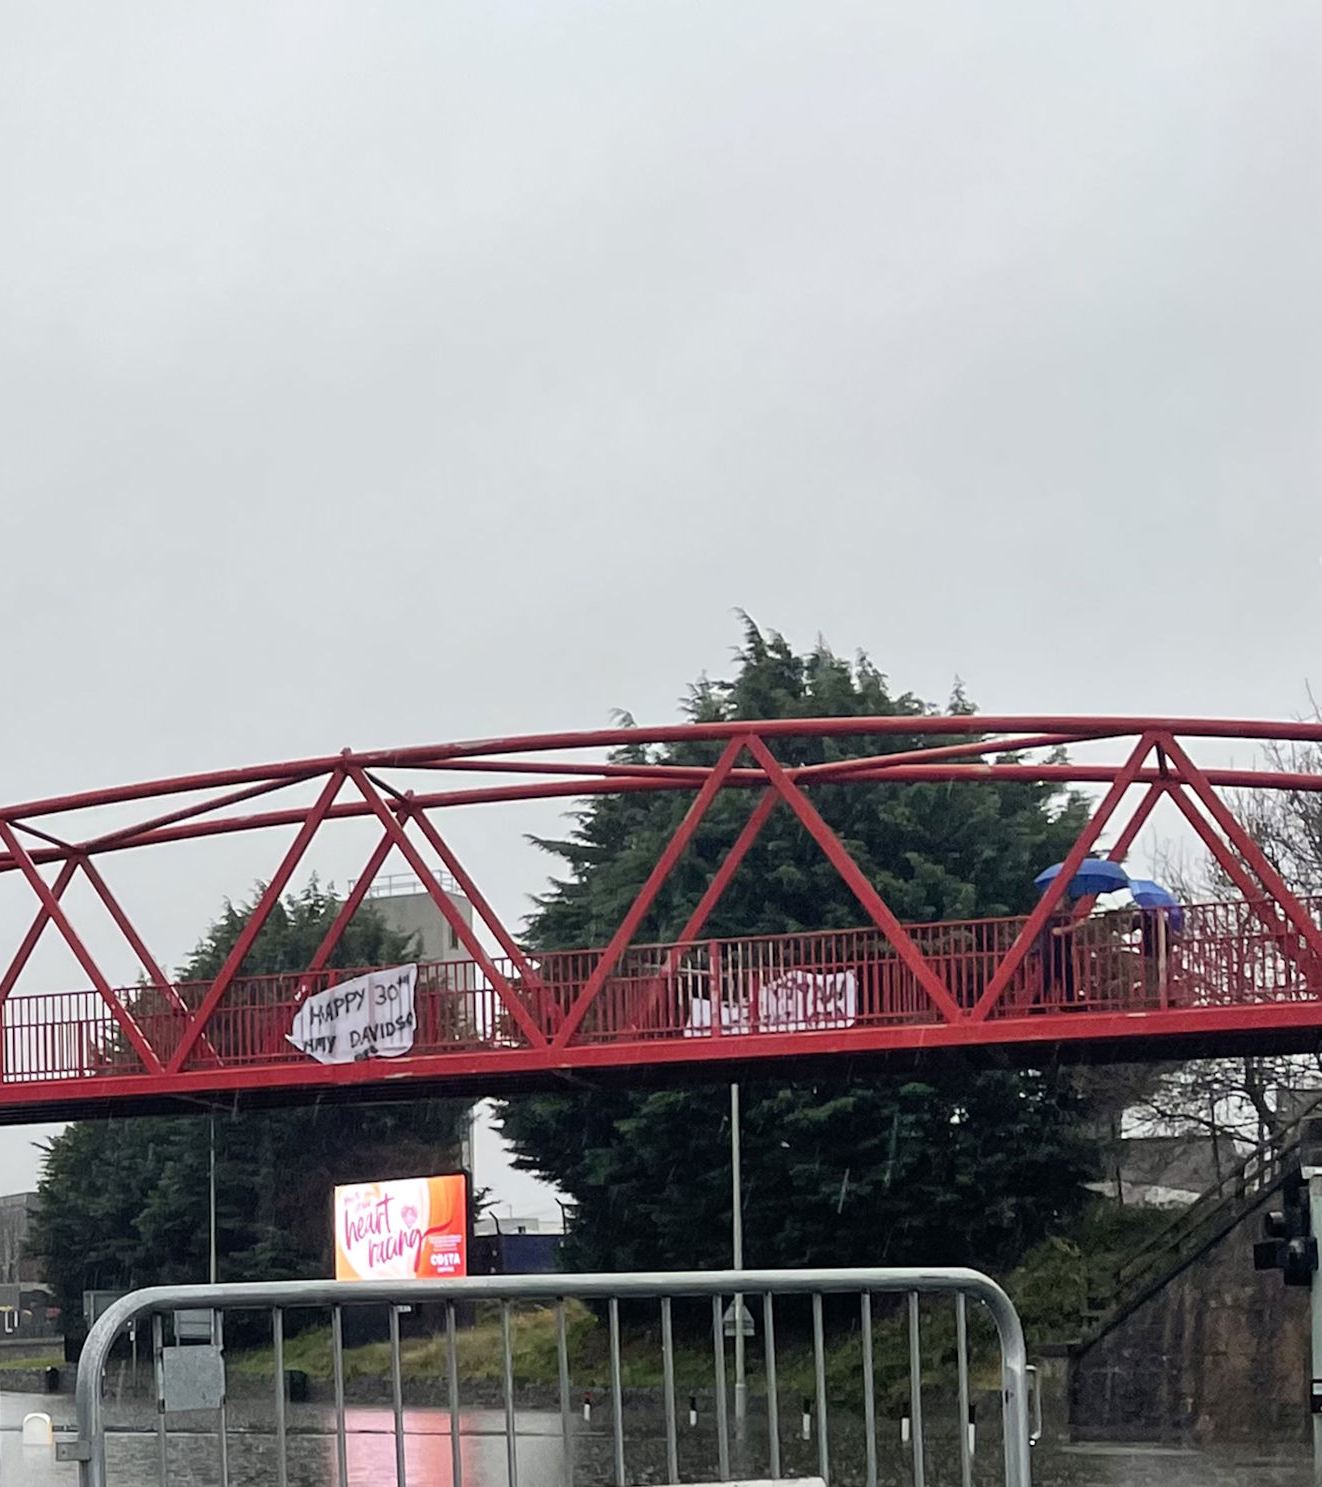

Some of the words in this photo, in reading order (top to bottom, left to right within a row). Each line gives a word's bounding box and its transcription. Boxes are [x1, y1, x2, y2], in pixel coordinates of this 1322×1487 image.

[310, 988, 366, 1026] HAPPY
[345, 1193, 396, 1250] heart
[368, 1228, 426, 1273] racing
[429, 1252, 461, 1267] COSTA
